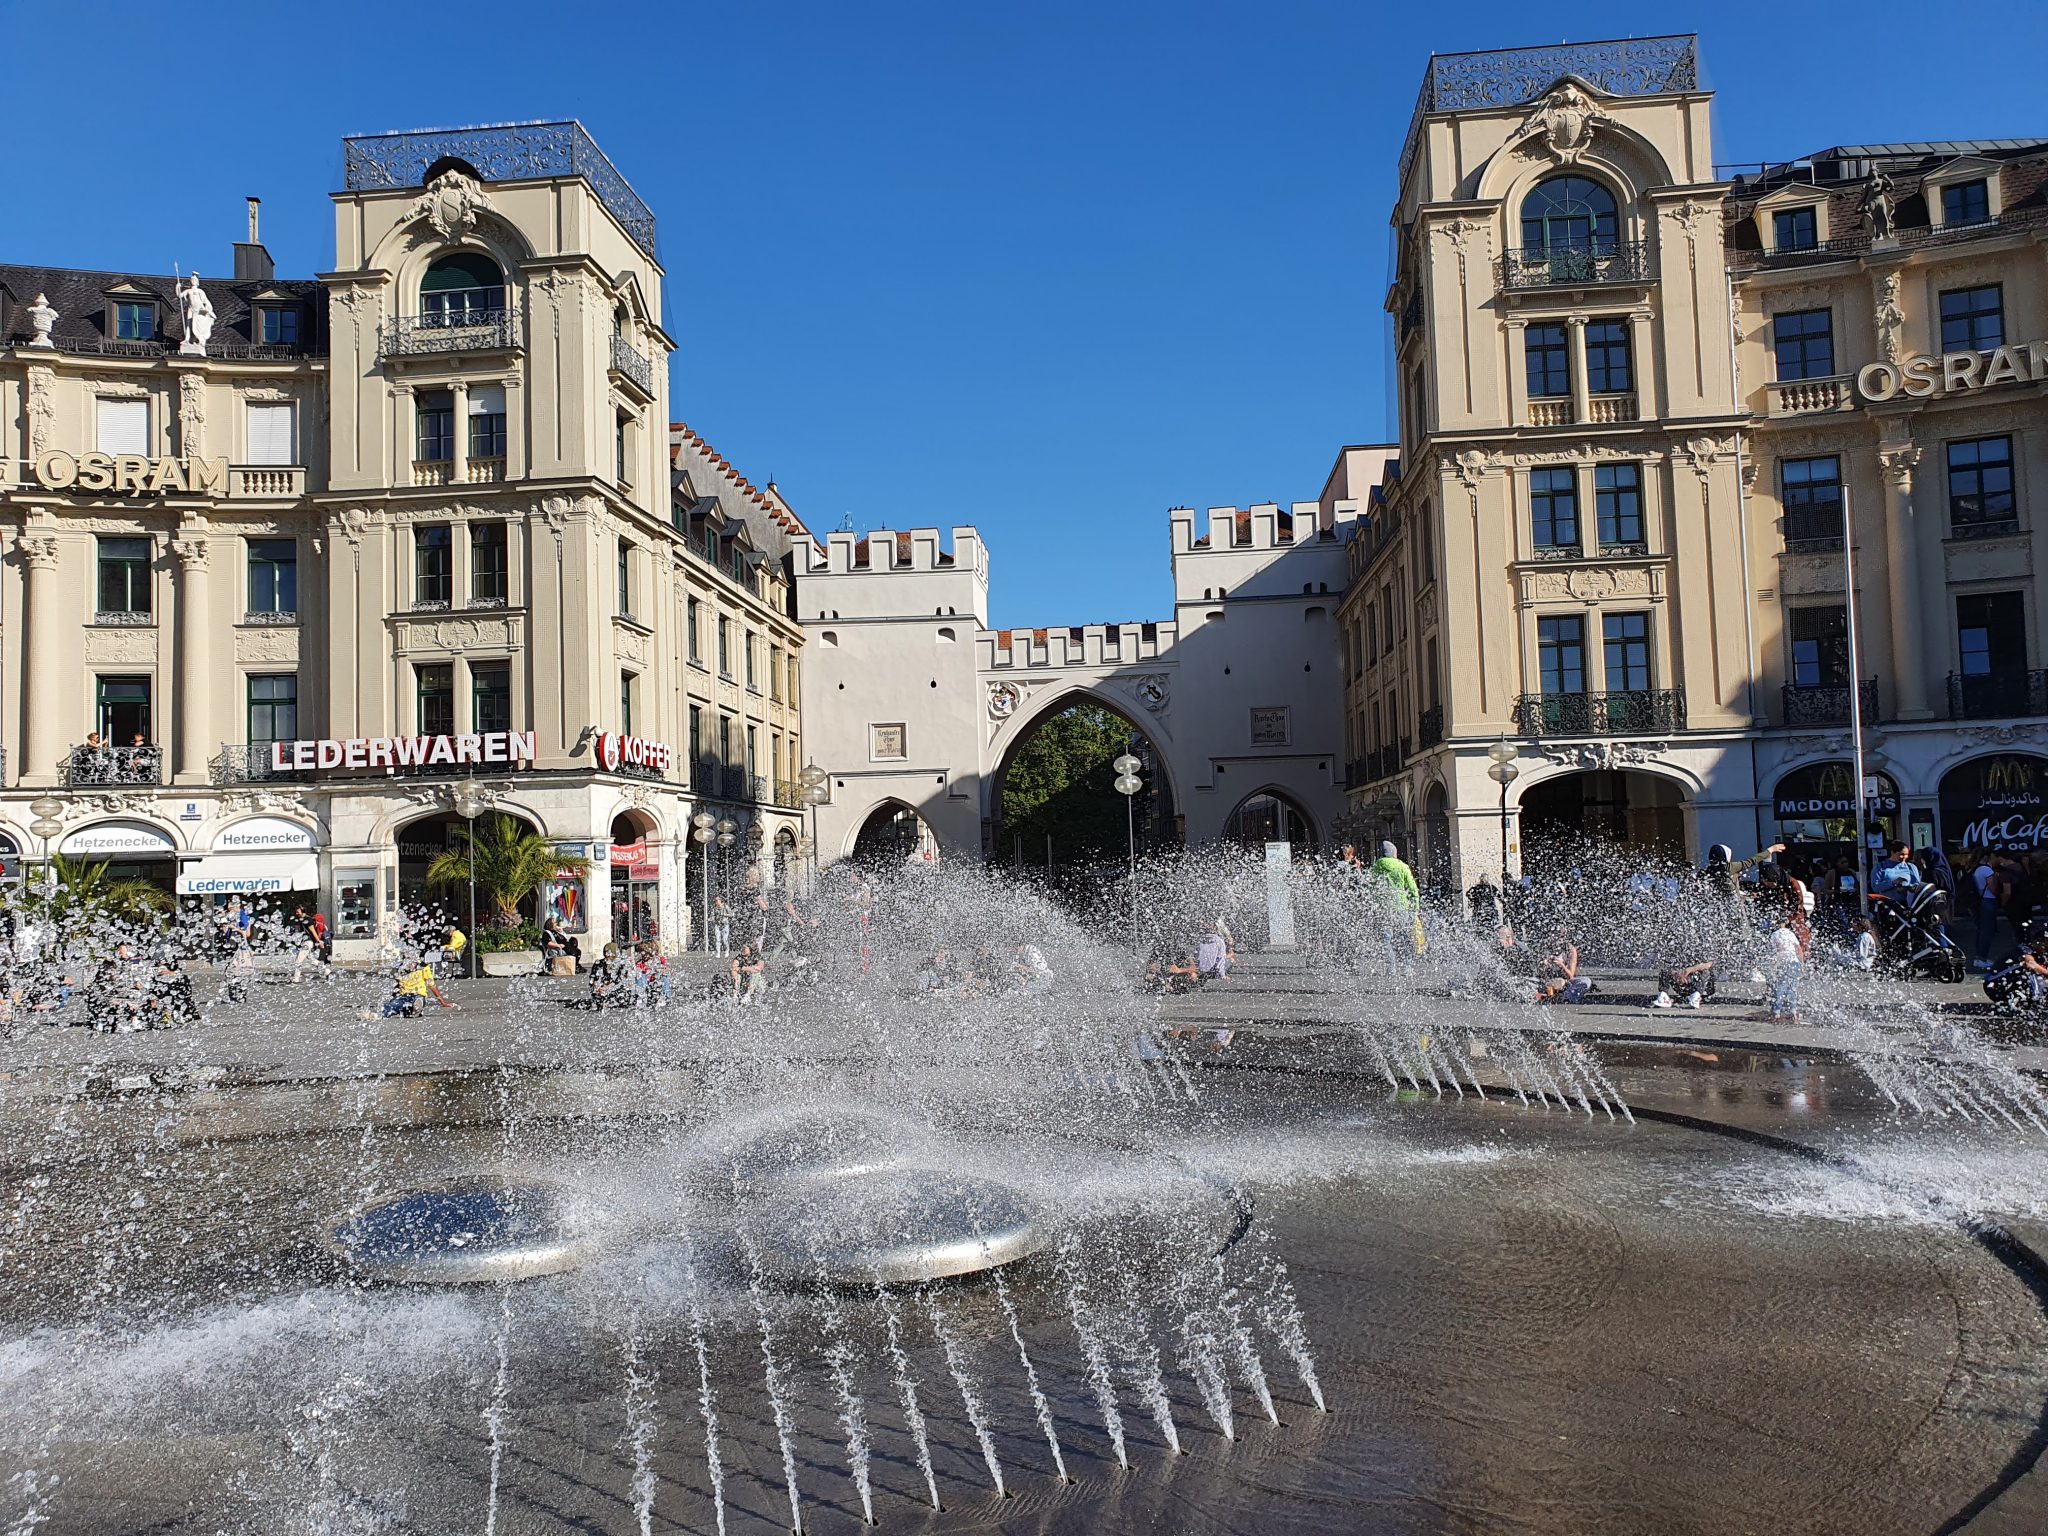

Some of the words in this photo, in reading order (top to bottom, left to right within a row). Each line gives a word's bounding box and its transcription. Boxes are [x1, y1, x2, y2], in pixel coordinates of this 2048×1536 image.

[35, 450, 230, 492] OSRAM
[271, 731, 537, 771] LEDERWAREN
[622, 735, 672, 770] KOFFER
[73, 837, 163, 848] Hetzenecker
[223, 833, 307, 845] Hetzenecker
[187, 878, 281, 892] Lederwaren
